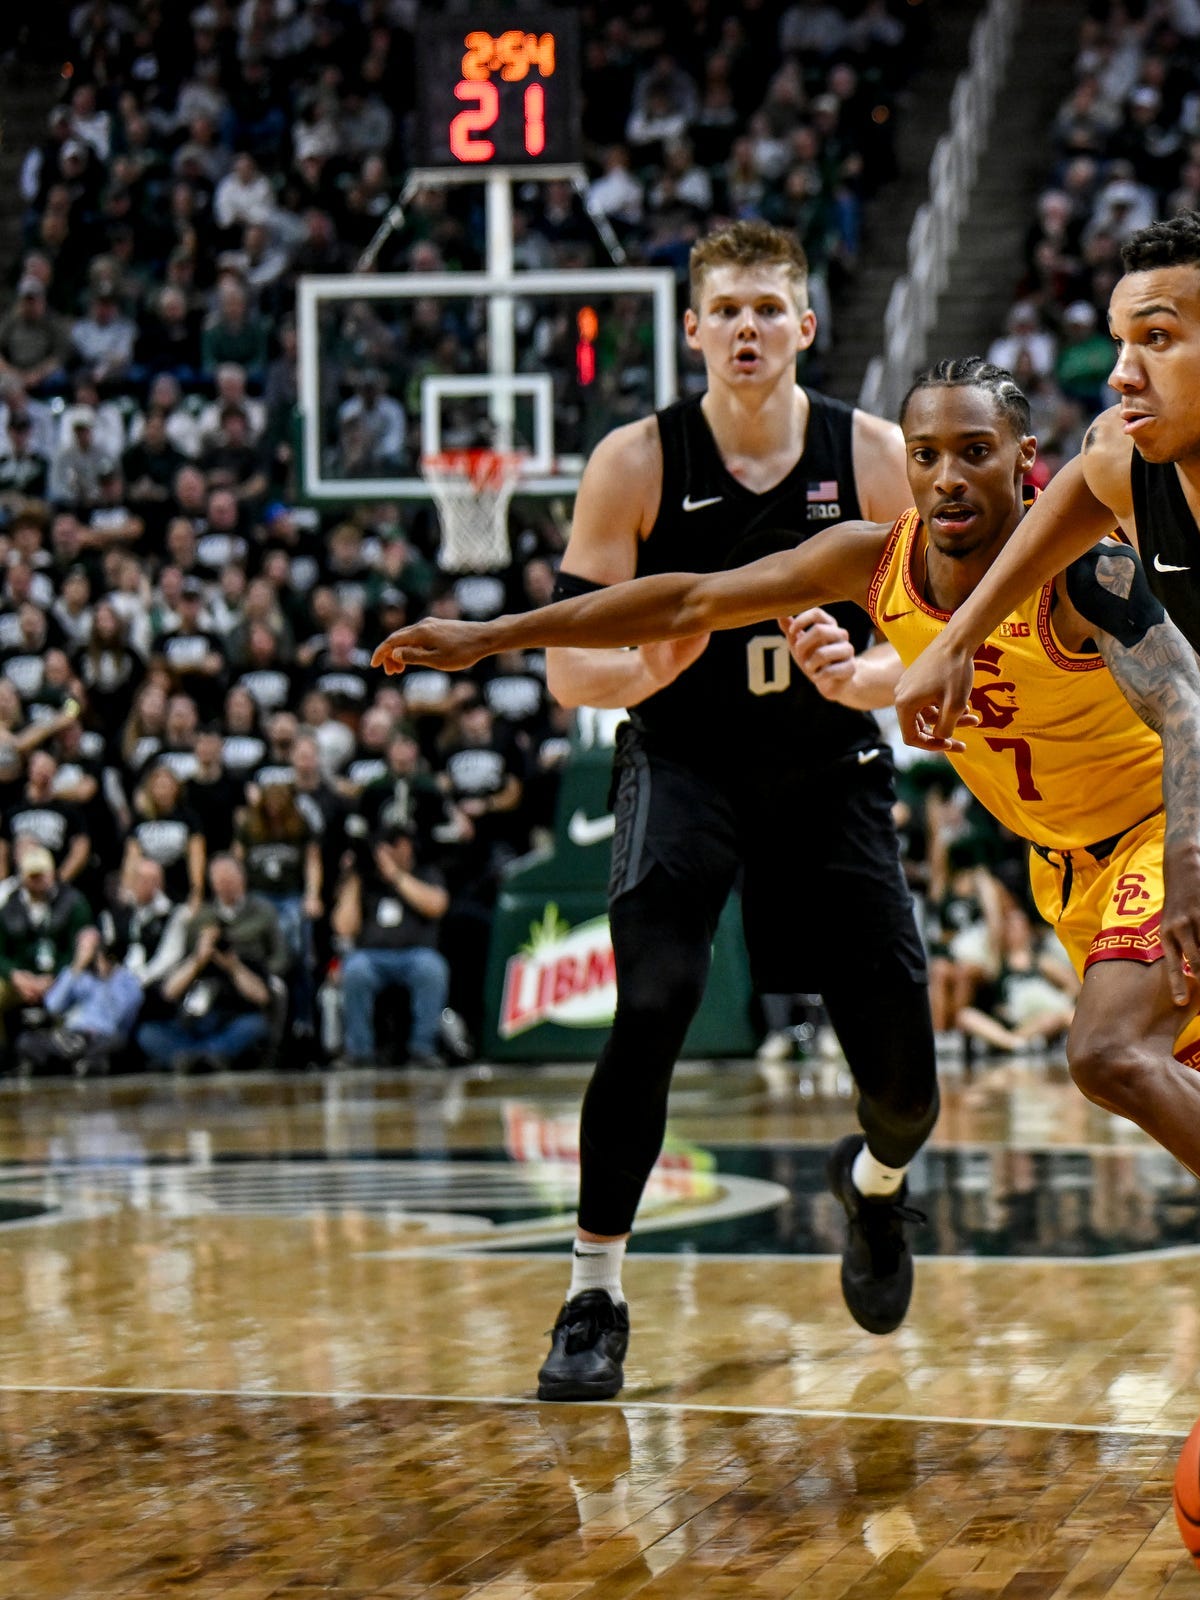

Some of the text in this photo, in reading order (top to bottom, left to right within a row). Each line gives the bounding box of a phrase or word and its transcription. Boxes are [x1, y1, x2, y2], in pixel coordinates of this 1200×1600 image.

[450, 80, 545, 162] 21
[746, 635, 791, 696] 0
[983, 736, 1044, 801] 7
